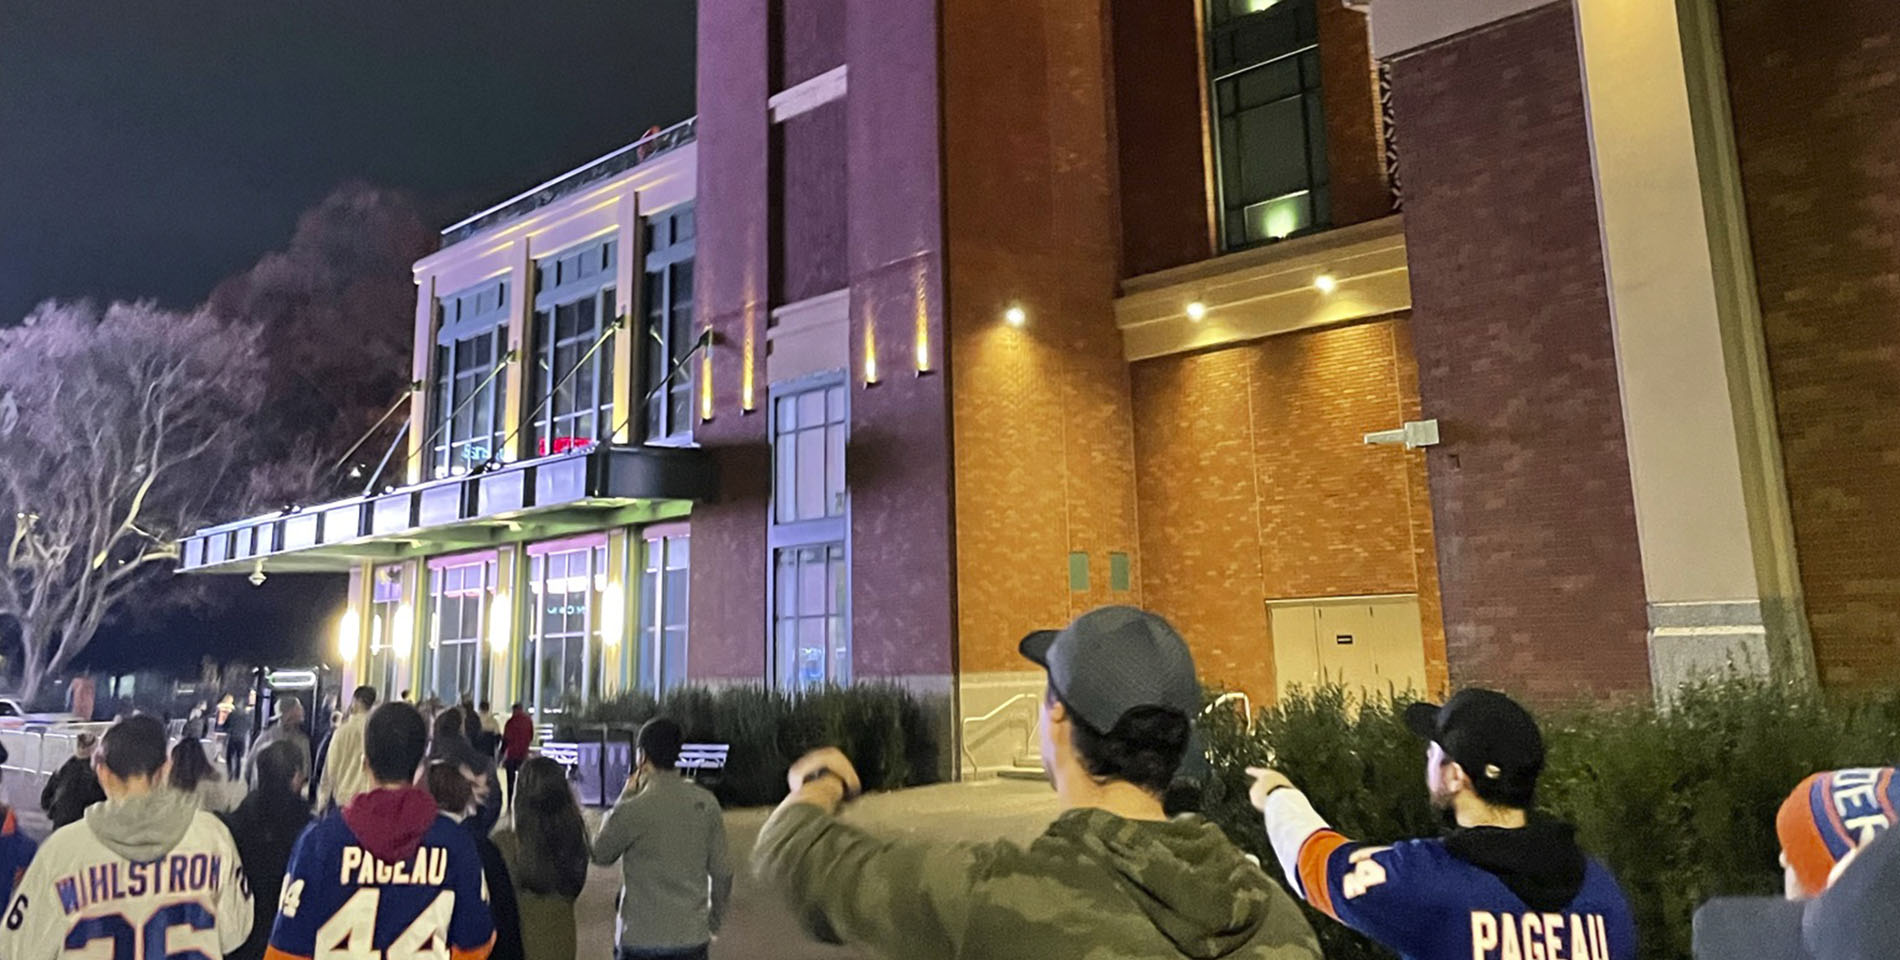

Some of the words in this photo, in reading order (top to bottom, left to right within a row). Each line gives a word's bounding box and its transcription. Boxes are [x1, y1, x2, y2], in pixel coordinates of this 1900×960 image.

[340, 846, 448, 886] PAGEAU
[6, 894, 29, 931] 6
[314, 888, 456, 960] 44
[1471, 911, 1608, 960] PAGEAU
